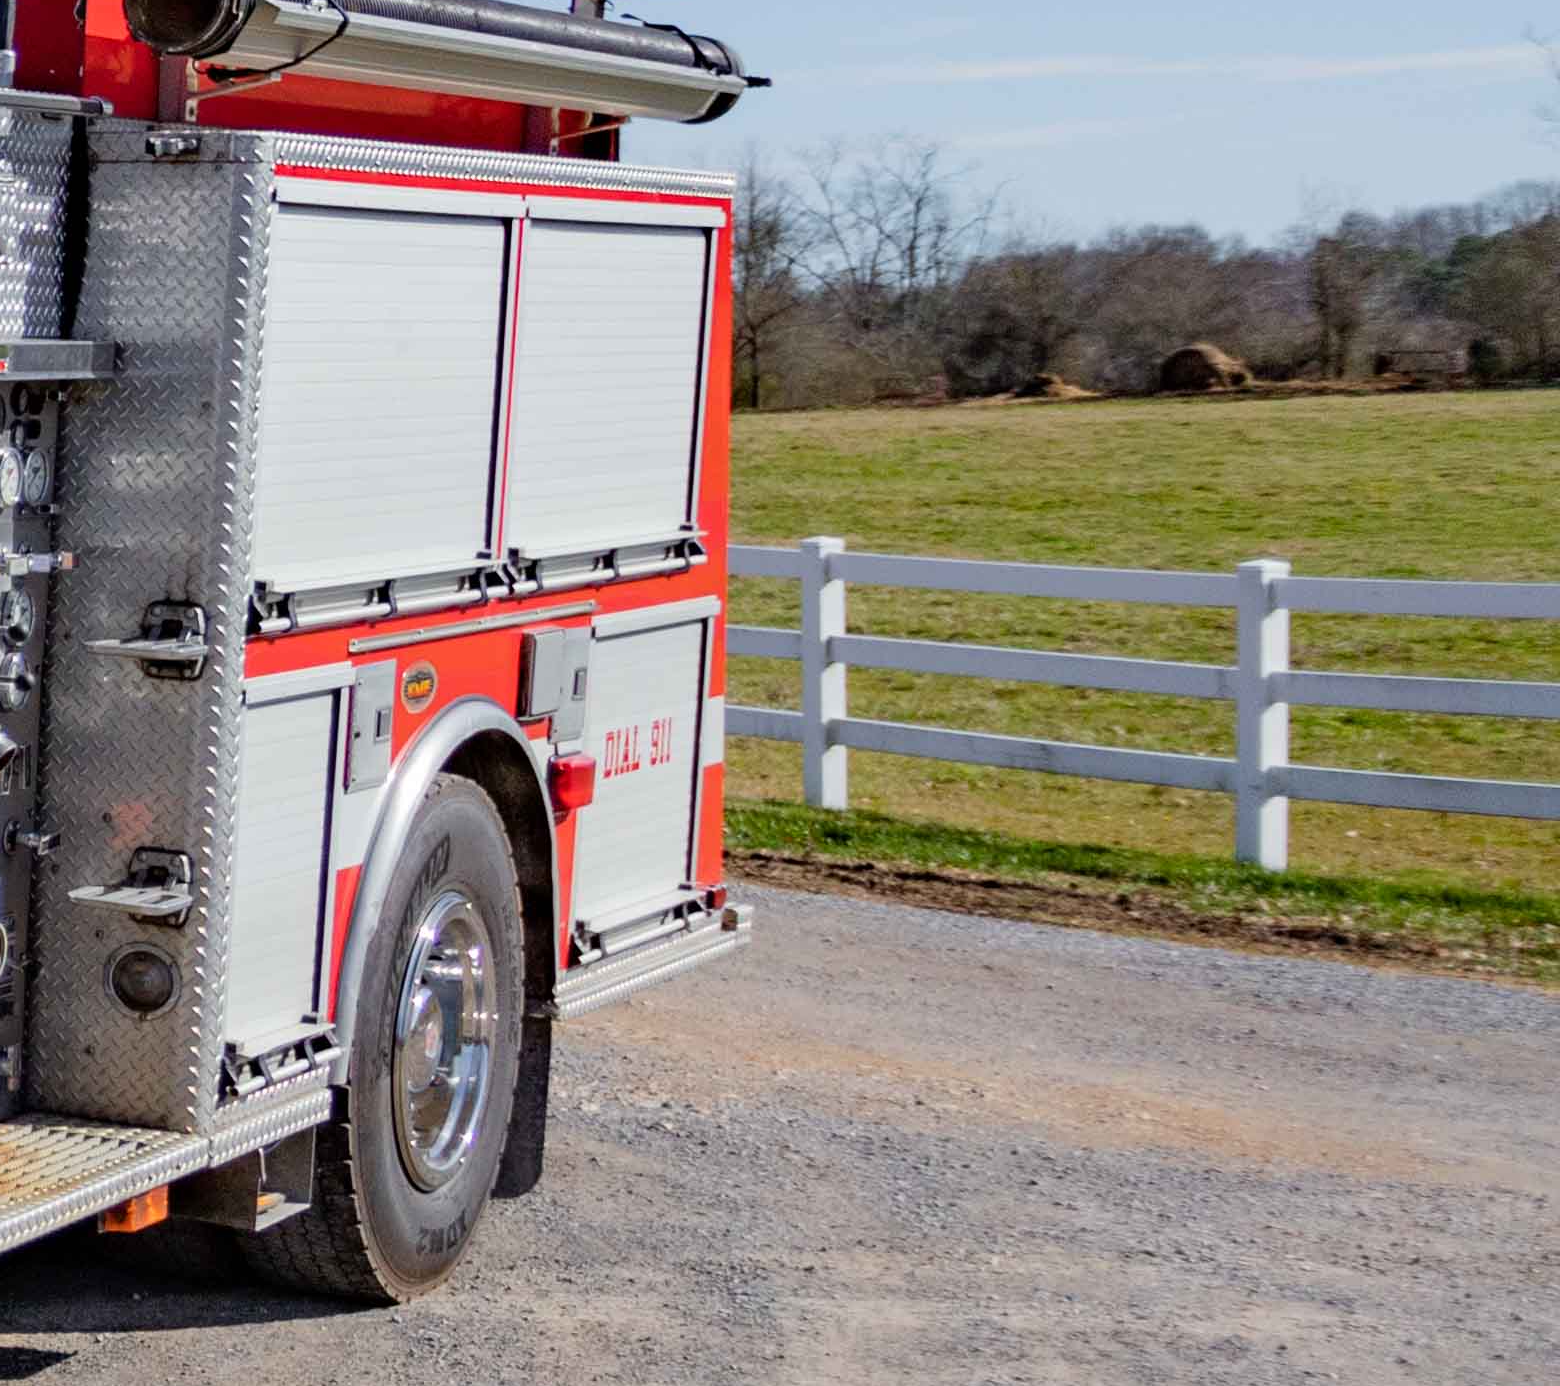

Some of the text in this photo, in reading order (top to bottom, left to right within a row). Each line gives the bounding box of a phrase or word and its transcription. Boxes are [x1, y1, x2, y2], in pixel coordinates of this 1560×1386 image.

[407, 679, 432, 699] KME
[603, 717, 672, 779] DIAL 911
